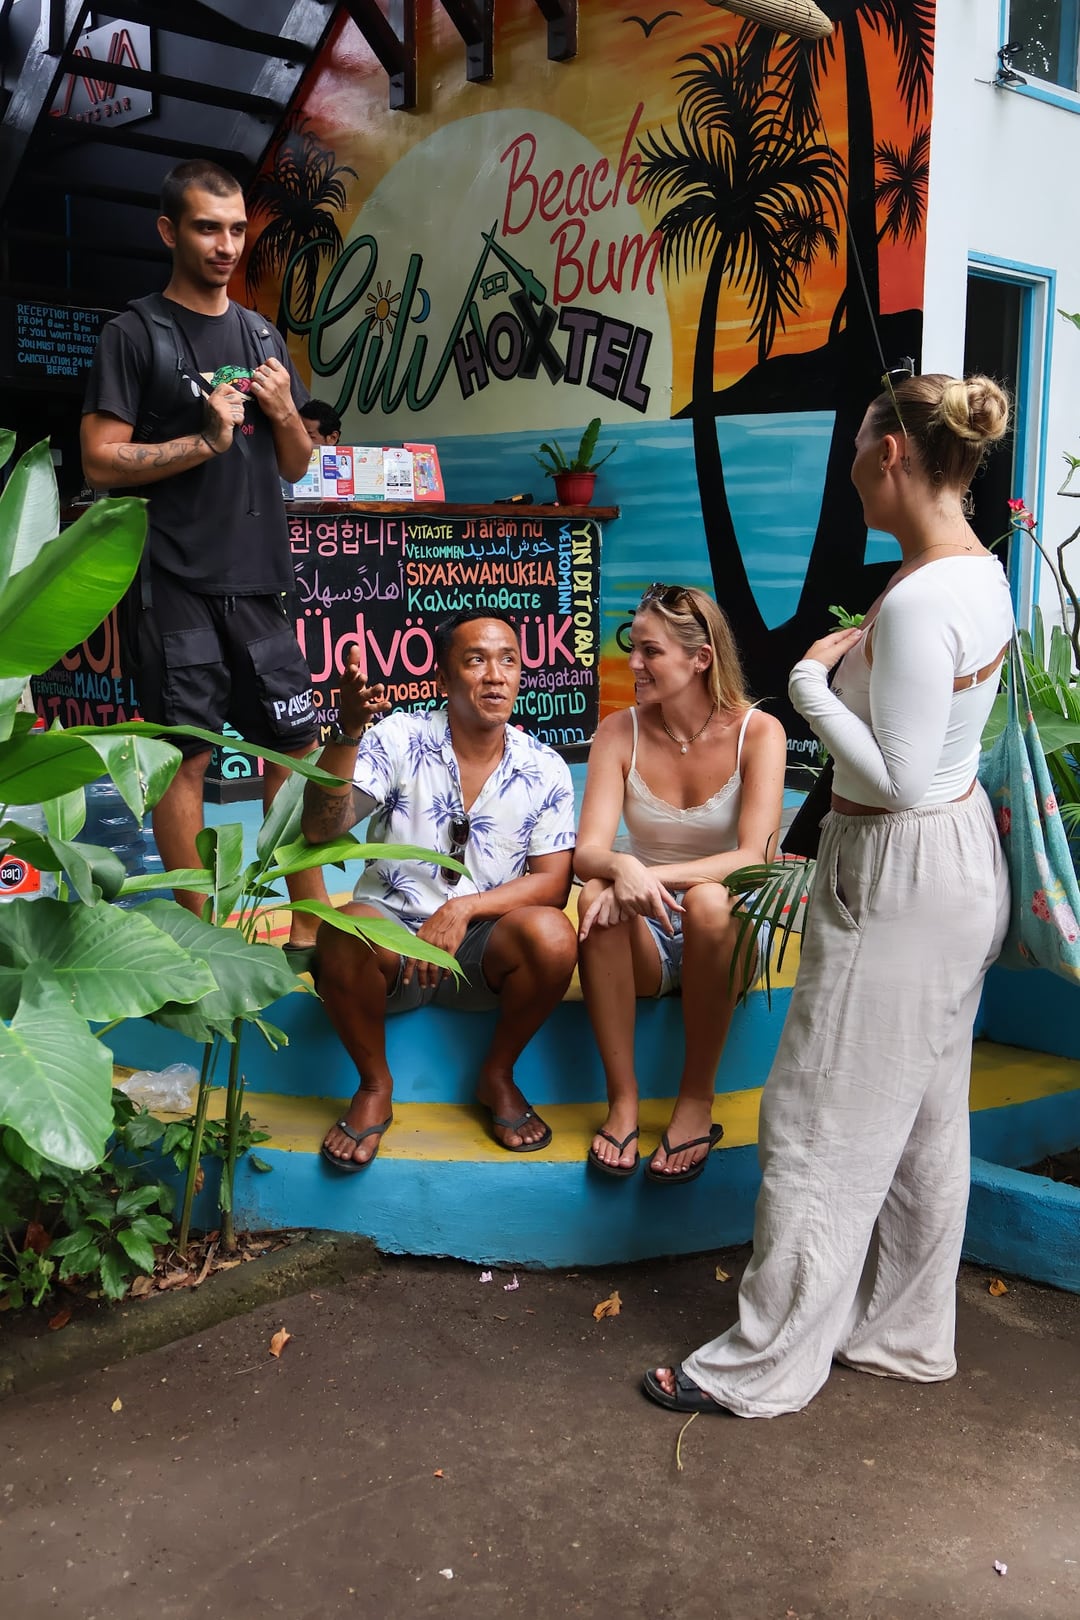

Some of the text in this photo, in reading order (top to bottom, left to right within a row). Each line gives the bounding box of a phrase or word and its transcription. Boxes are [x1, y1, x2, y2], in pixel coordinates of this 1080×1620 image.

[500, 102, 650, 237] Beach
[550, 218, 663, 306] Bum
[17, 304, 99, 324] RECEPTION OPEN
[17, 315, 43, 326] FROM
[283, 233, 466, 418] Gili
[17, 338, 35, 350] YOU
[36, 340, 55, 351] MUST
[18, 326, 27, 335] IF
[30, 328, 47, 338] YOU
[50, 330, 72, 341] WANT
[72, 357, 83, 367] 24
[452, 288, 653, 414] HOXTEL
[46, 365, 78, 376] BEFORE
[288, 517, 409, 557] 환영합니다
[408, 524, 453, 540] VITAJTE
[405, 544, 464, 560] VELKOMMEN
[572, 523, 593, 565] YIN
[406, 560, 557, 587] SIYAKWAMUKELA
[557, 523, 572, 615] VELKOMINN
[573, 570, 592, 593] DI
[407, 588, 473, 612] Καλώς
